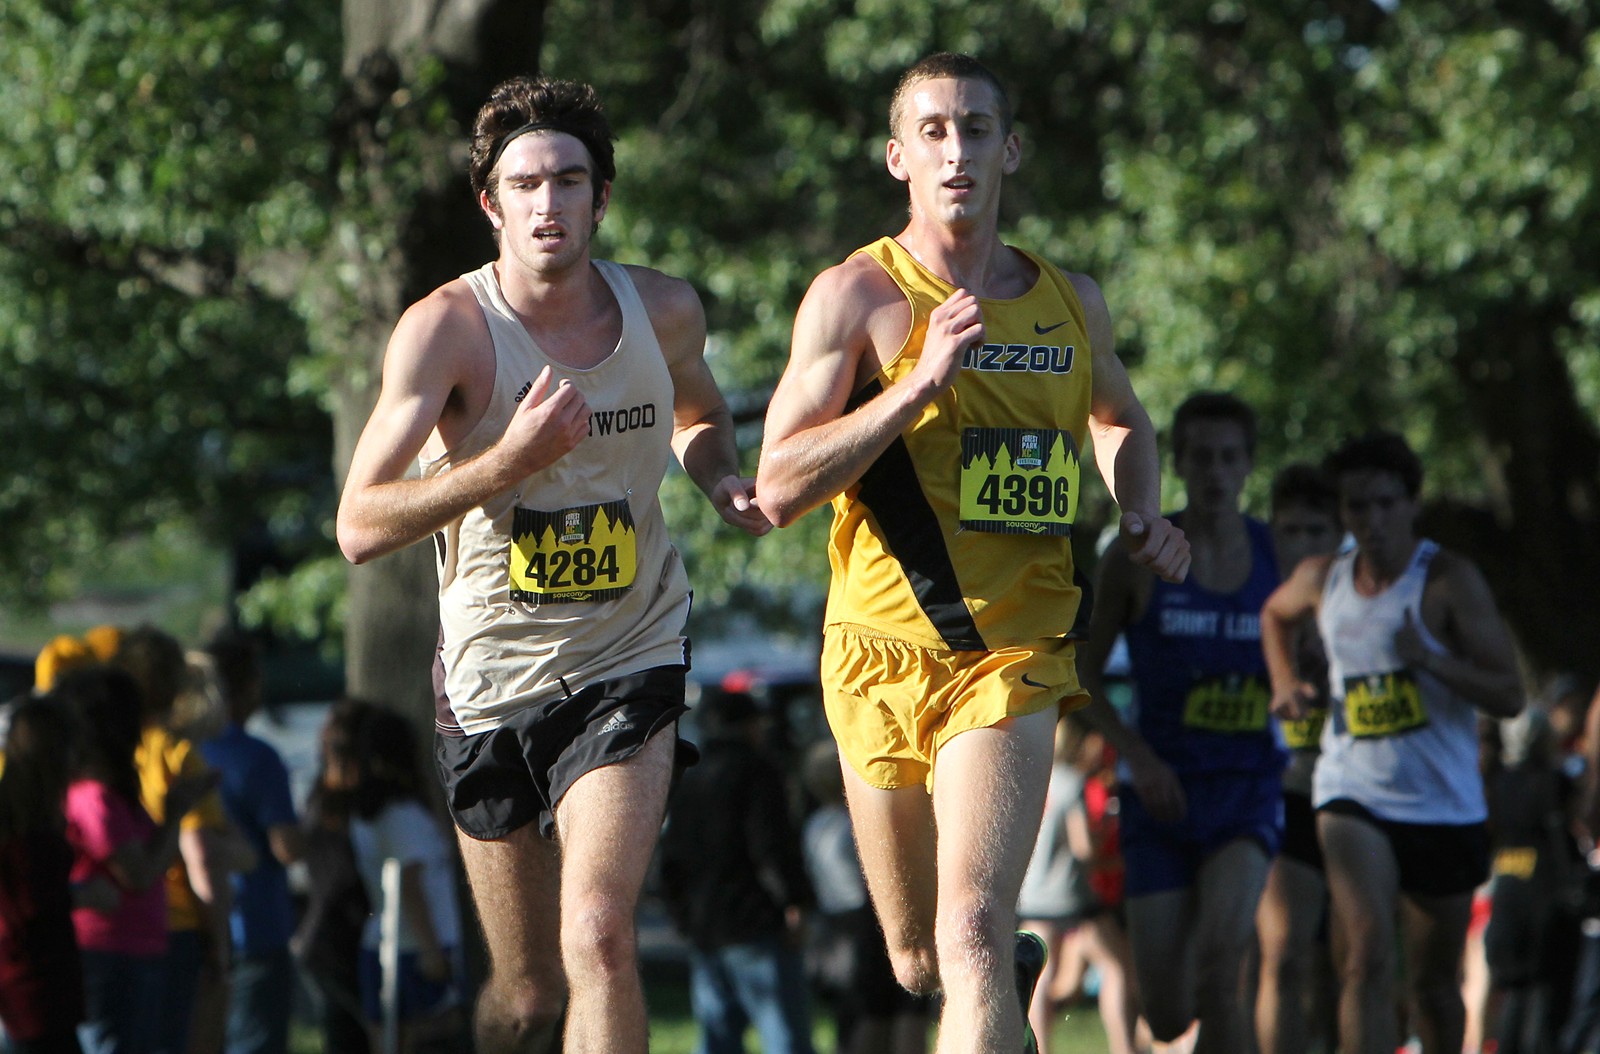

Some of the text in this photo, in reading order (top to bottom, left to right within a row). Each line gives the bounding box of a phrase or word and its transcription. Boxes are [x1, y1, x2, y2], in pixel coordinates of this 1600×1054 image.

[1022, 435, 1038, 443] FOREST
[977, 474, 1069, 518] 4396
[565, 513, 580, 521] FOREST
[1006, 521, 1039, 529] saucony
[525, 545, 620, 589] 4284
[552, 591, 585, 600] saucony
[1161, 608, 1218, 636] SAINT
